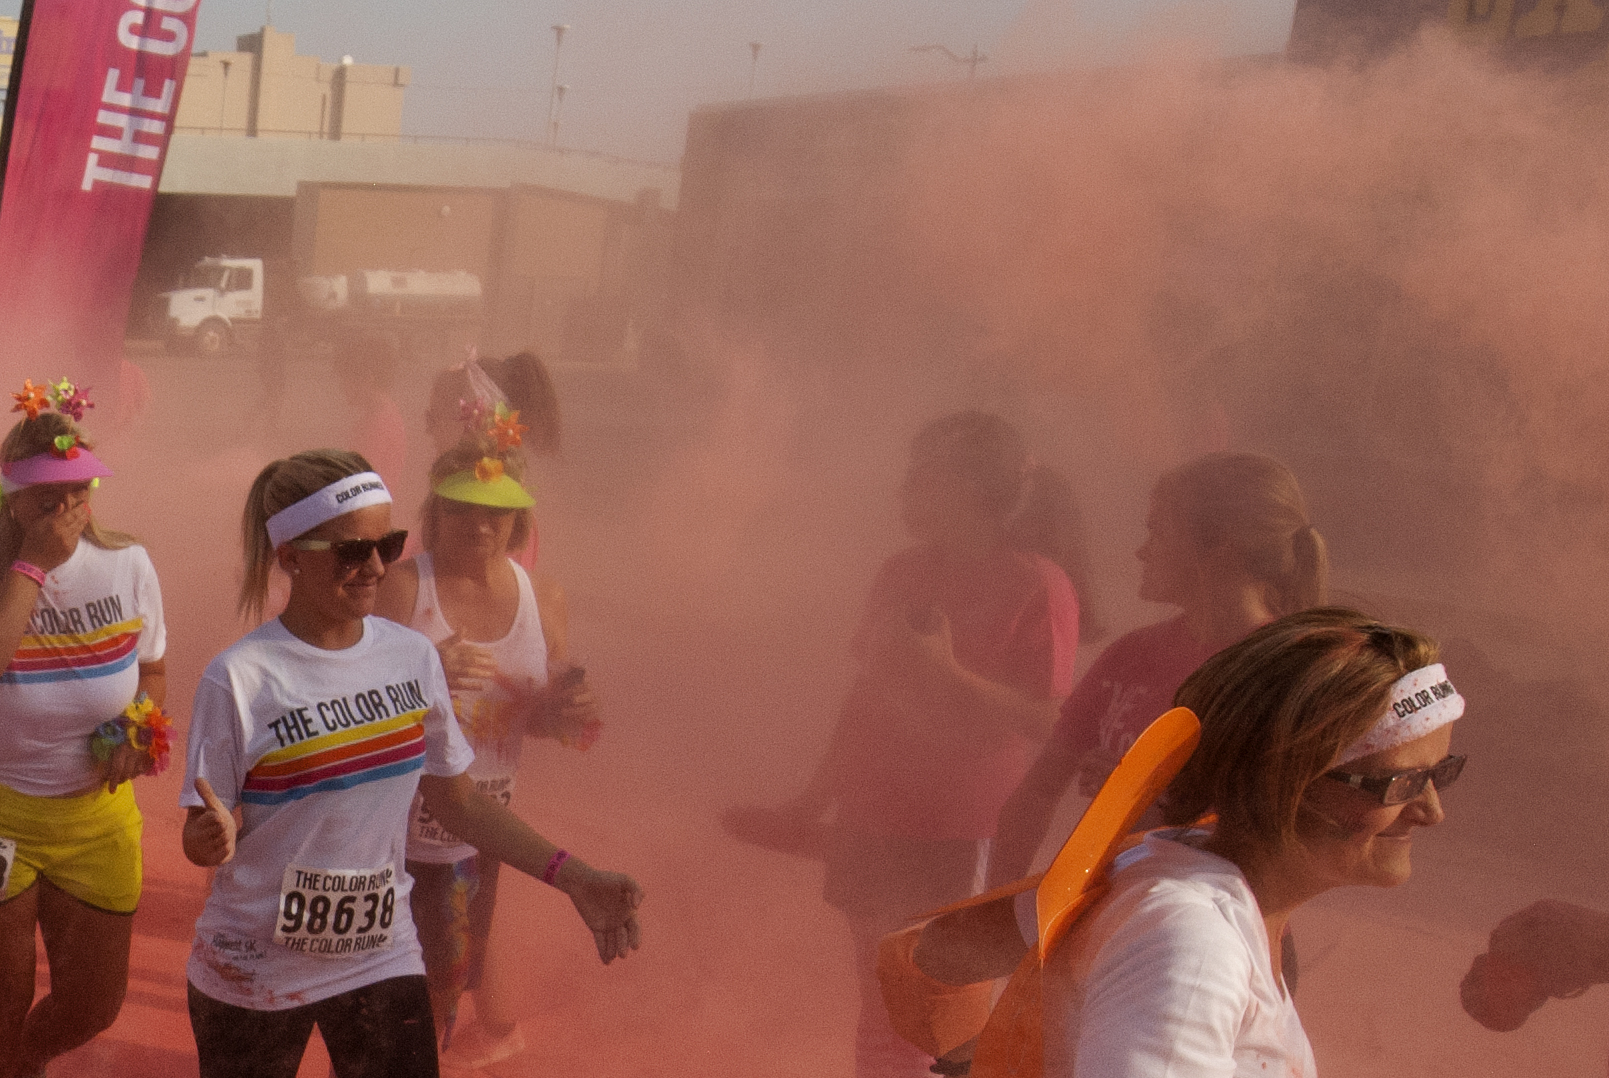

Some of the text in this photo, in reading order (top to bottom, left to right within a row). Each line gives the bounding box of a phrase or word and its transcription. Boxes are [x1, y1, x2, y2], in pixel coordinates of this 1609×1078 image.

[81, 67, 177, 192] THE
[85, 594, 123, 631] RUN
[267, 679, 429, 748] THE COLOR RUN
[1392, 689, 1435, 718] COLOR
[295, 869, 321, 891] THE
[322, 874, 367, 893] COLOR
[280, 886, 395, 936] 98638
[283, 933, 378, 955] THE COLOR RUN
